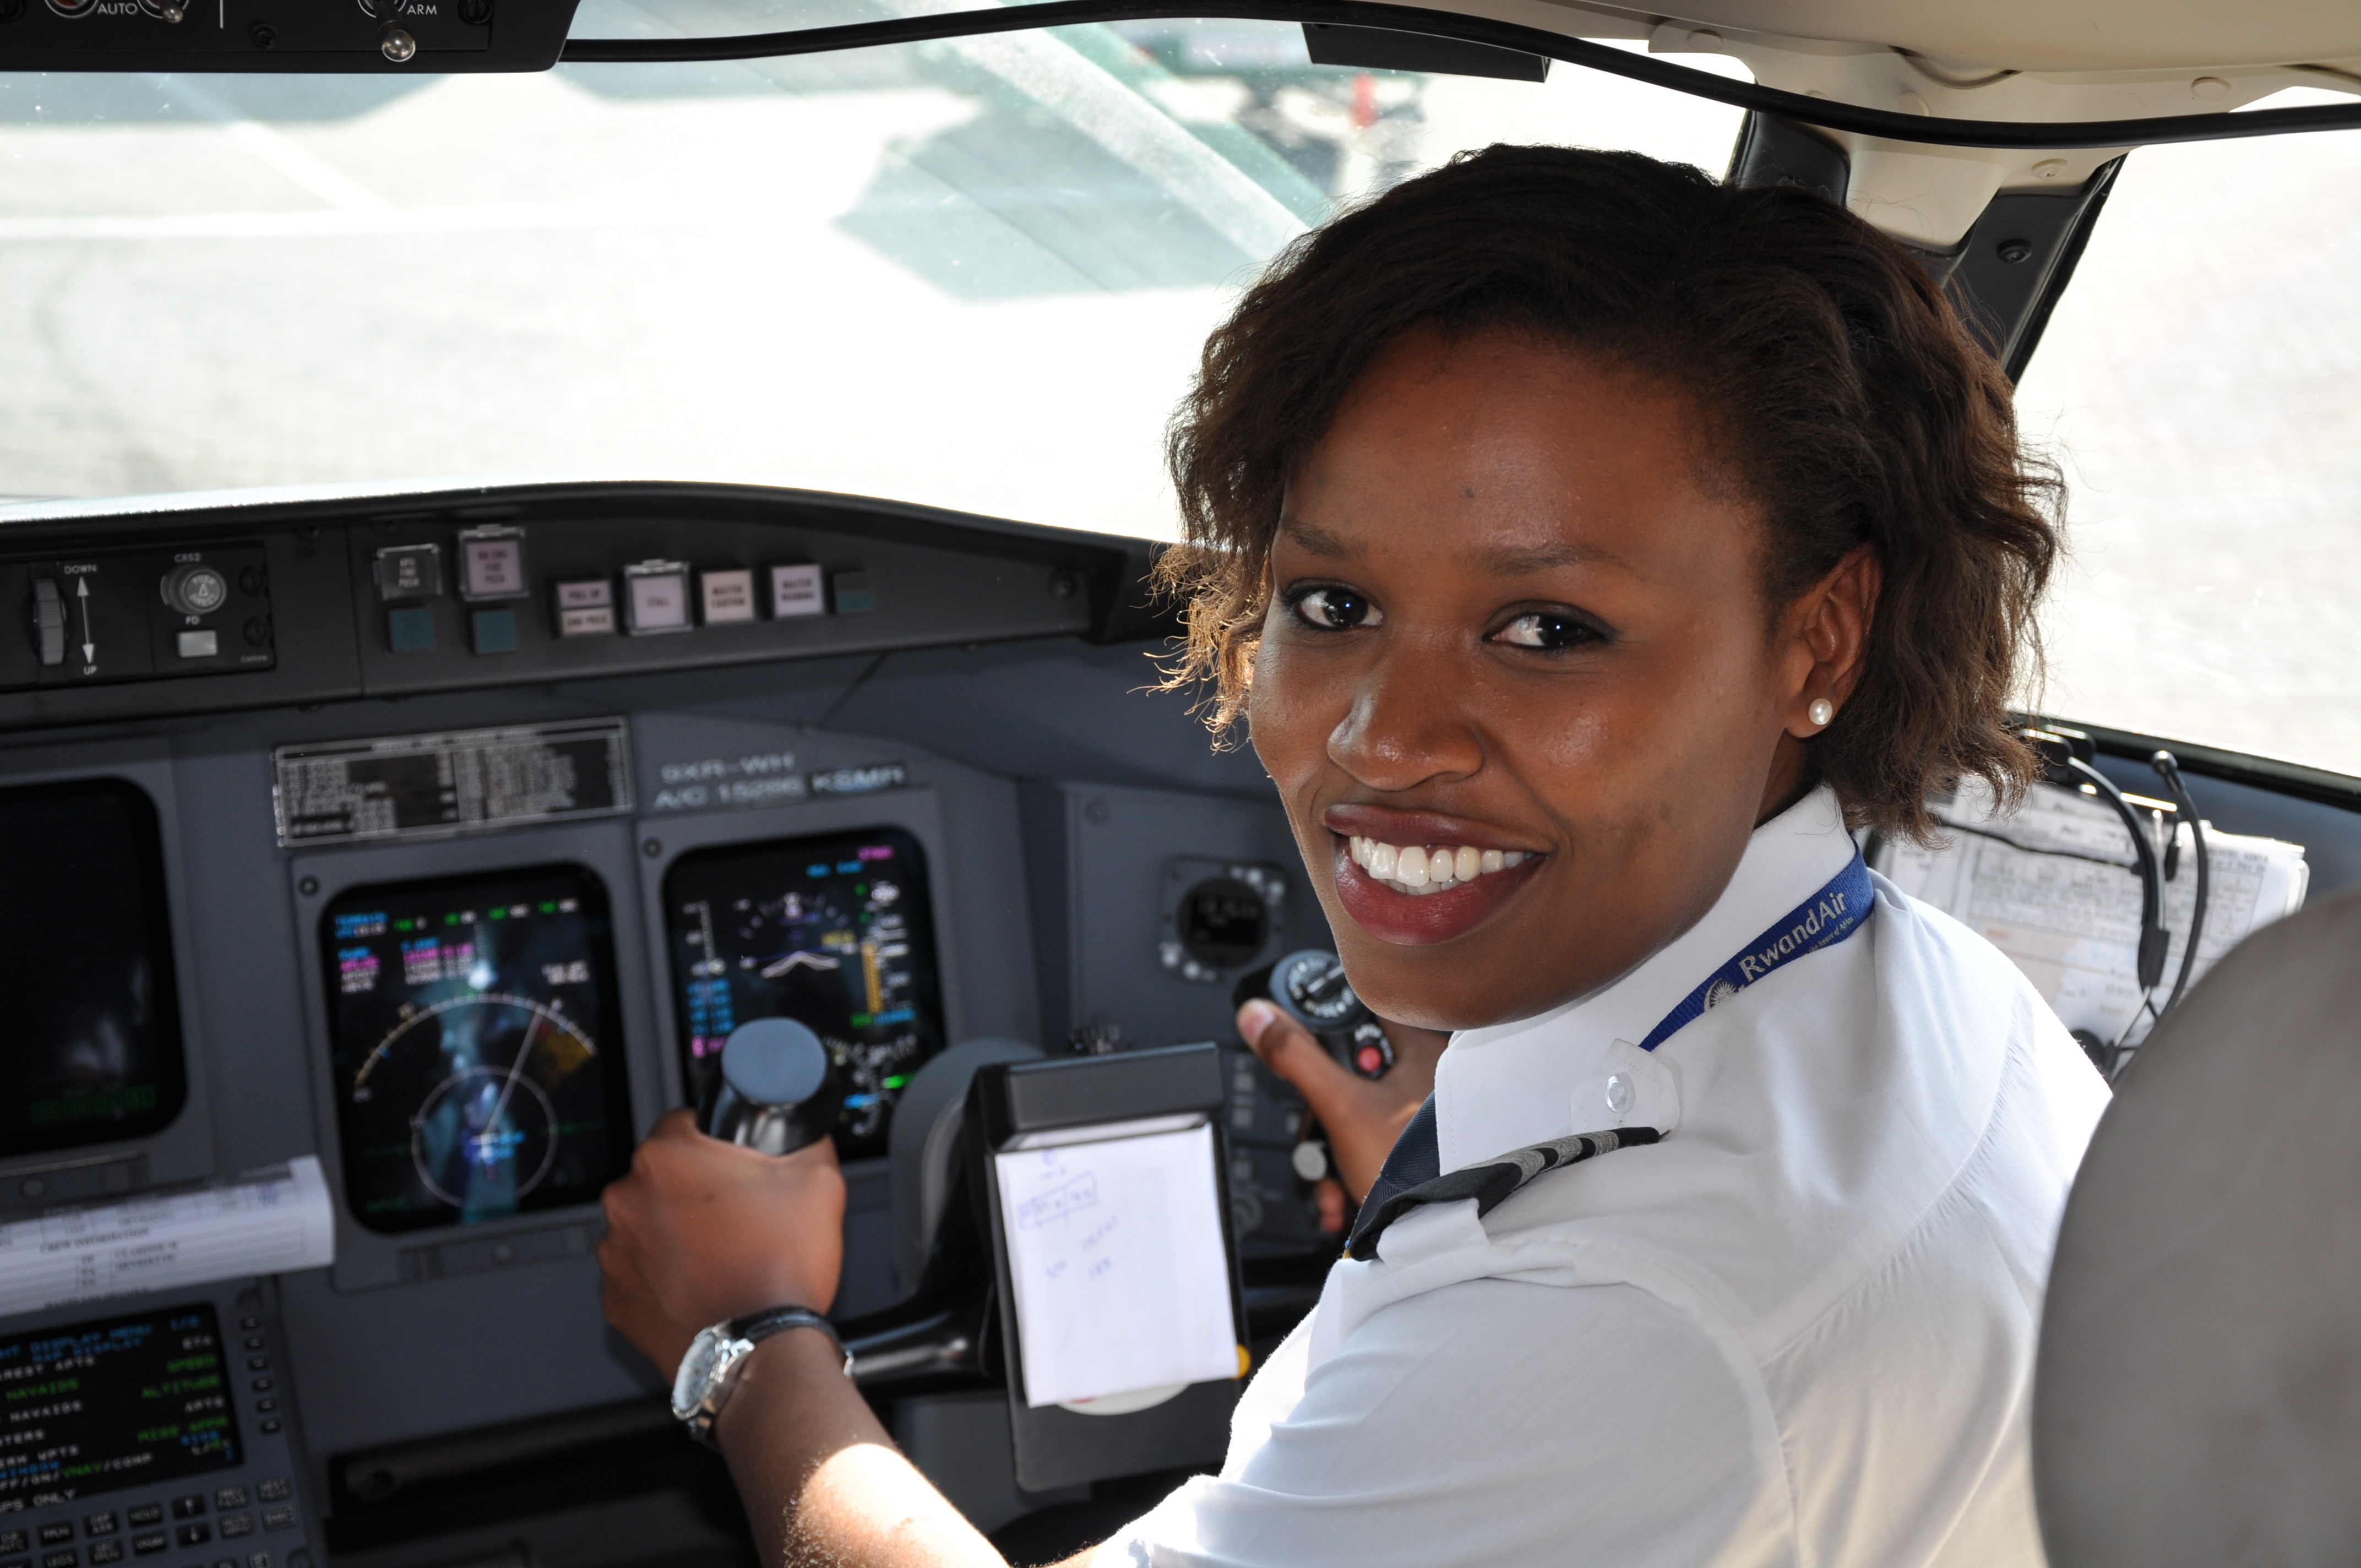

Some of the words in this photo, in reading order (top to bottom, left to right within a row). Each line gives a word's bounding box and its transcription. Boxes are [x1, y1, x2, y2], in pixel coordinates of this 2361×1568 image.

[97, 3, 138, 15] AUTO
[406, 4, 437, 15] ARM
[64, 563, 98, 575] DOWN
[185, 616, 202, 625] FD
[83, 665, 98, 675] UP
[1738, 892, 1846, 982] RwandAir
[0, 1362, 45, 1381] REST
[6, 1378, 80, 1401] NAVAIDS
[9, 1400, 83, 1423] NAVAIDS
[0, 1497, 25, 1513] PS
[33, 1488, 77, 1507] ONLY
